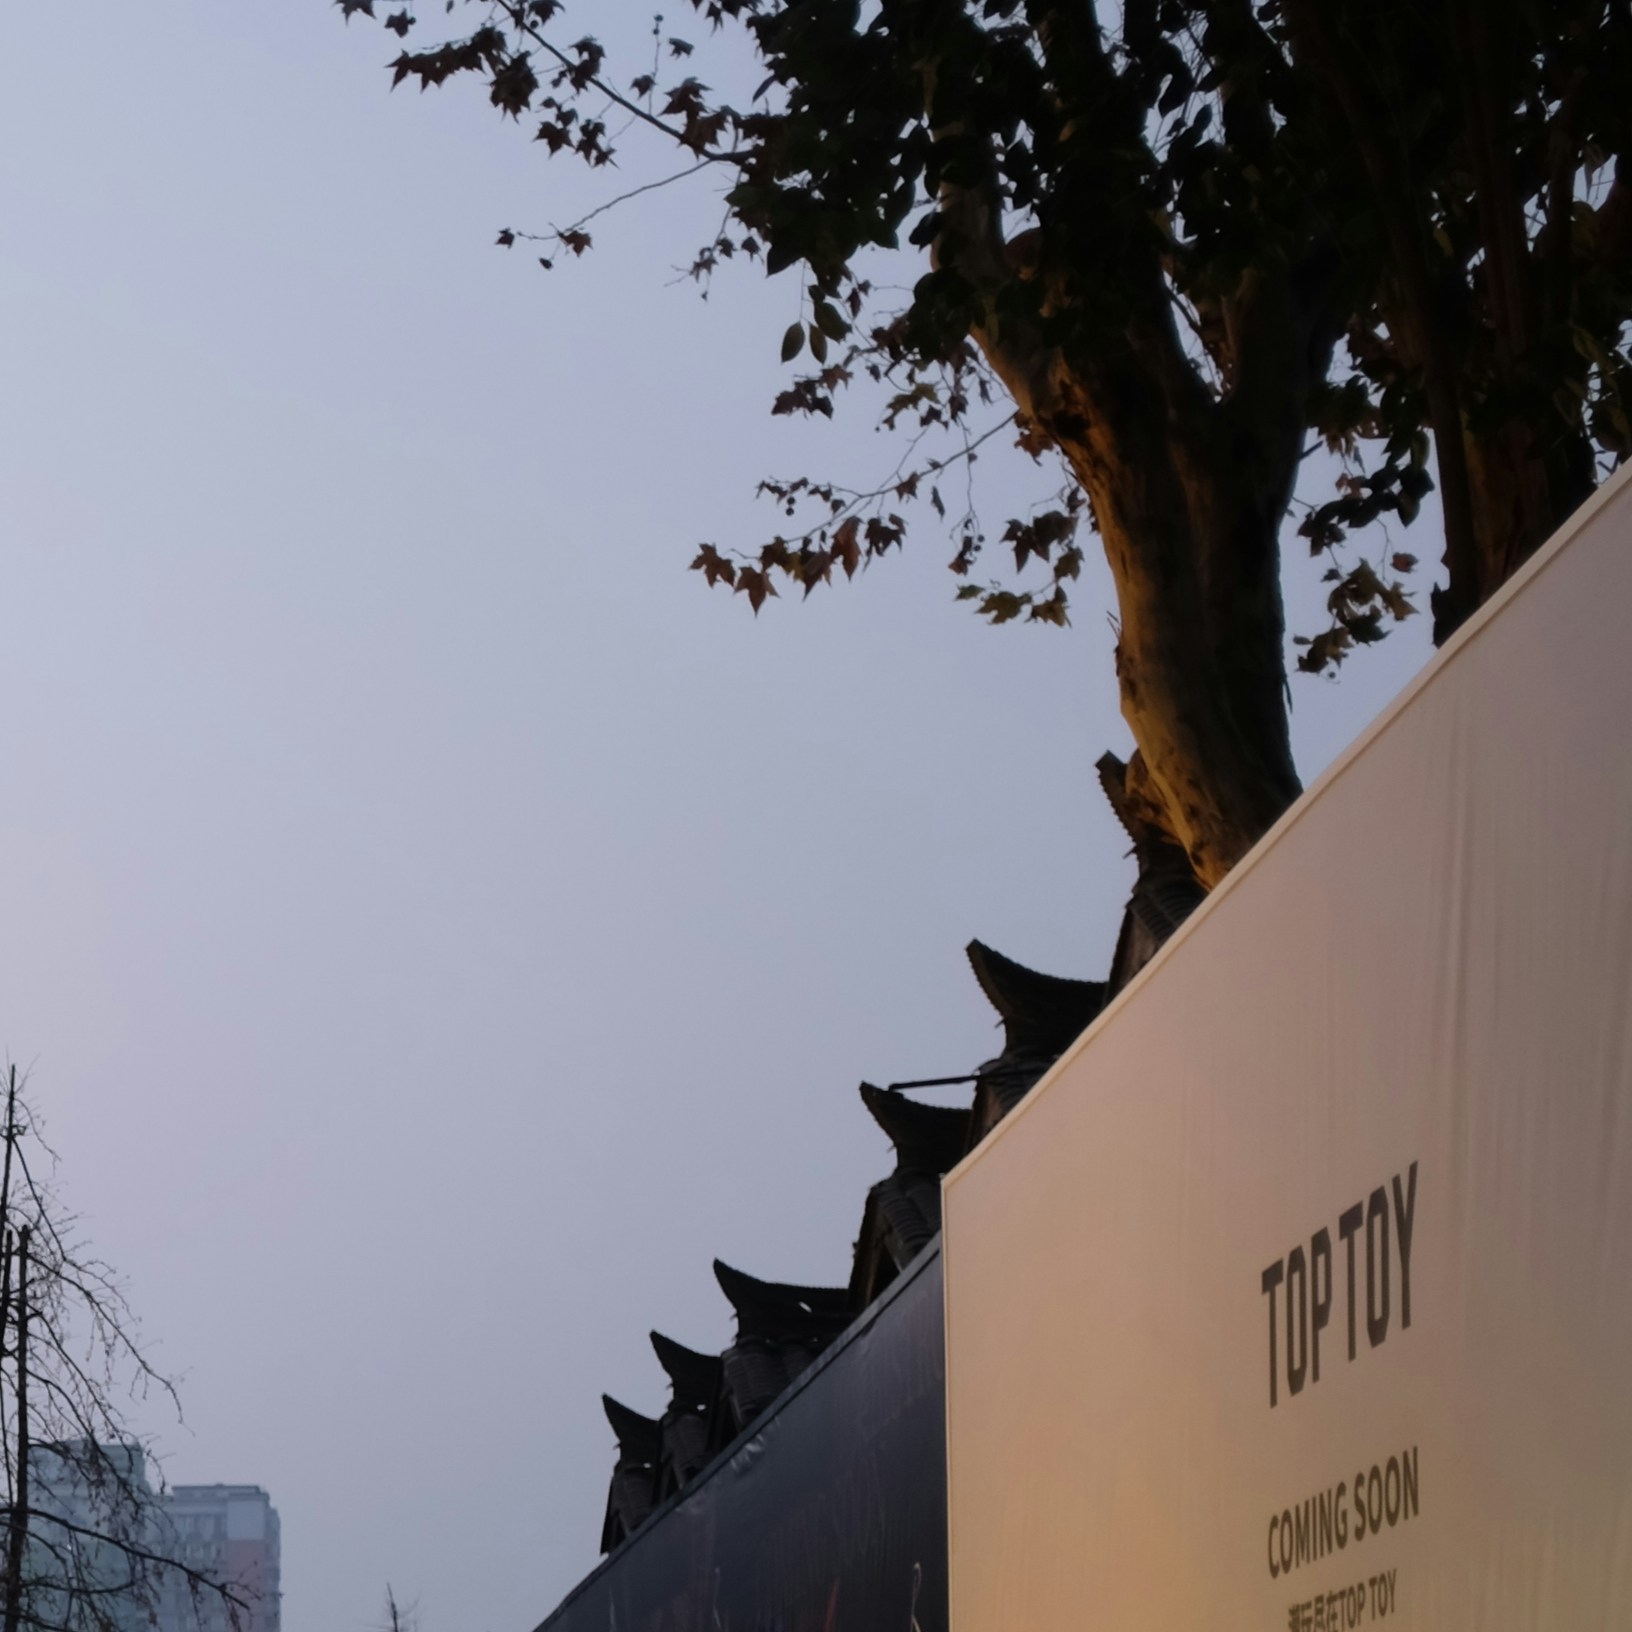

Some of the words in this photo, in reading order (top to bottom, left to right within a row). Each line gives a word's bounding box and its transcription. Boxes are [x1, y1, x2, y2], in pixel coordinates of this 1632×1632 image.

[1261, 1226, 1333, 1409] TOP
[1338, 1160, 1419, 1363] TOY
[1268, 1482, 1348, 1579] COMING
[1354, 1446, 1419, 1541] SOON
[1369, 1568, 1397, 1617] TOY
